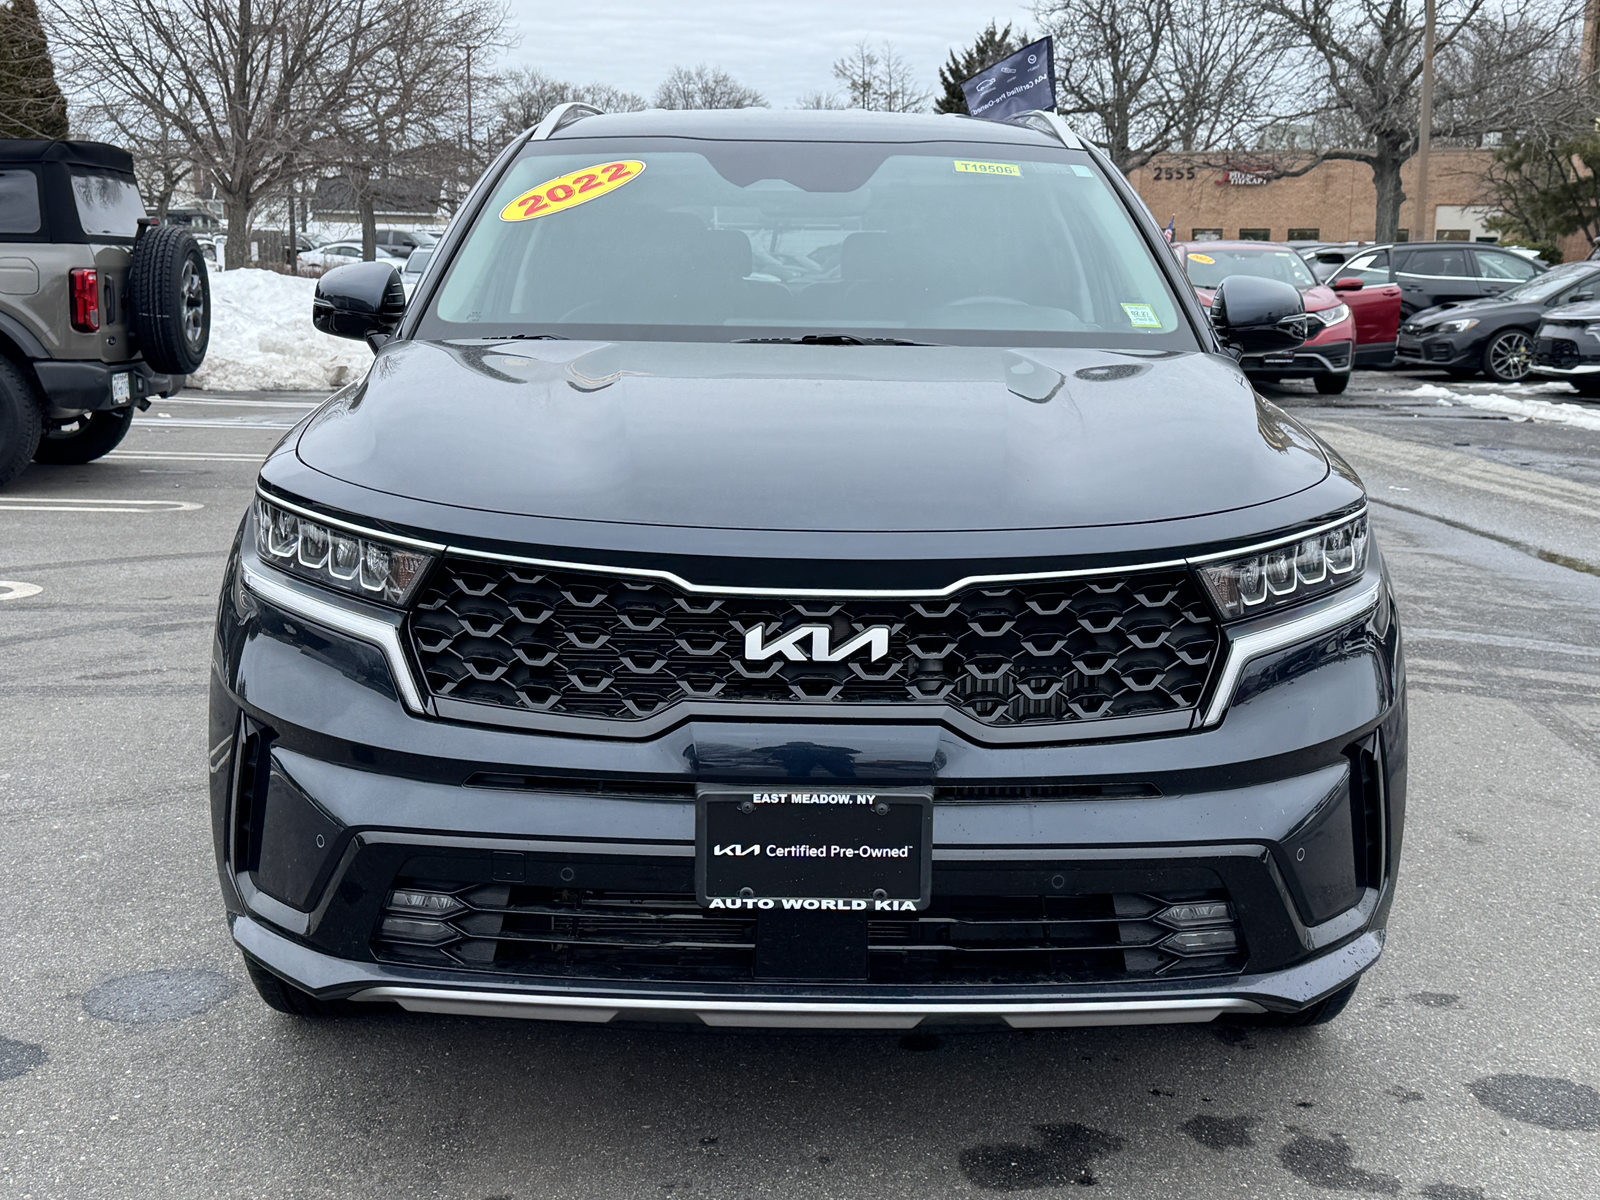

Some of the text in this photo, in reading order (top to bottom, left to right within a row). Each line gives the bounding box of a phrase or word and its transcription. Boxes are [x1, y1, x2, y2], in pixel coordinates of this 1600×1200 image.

[961, 162, 1013, 175] T19506
[1153, 167, 1196, 181] 2555
[518, 163, 634, 217] 2022
[746, 626, 888, 661] KIA
[754, 794, 787, 803] EAST
[857, 795, 875, 804] NY
[714, 845, 760, 855] KIA
[767, 845, 826, 857] Certified
[709, 899, 918, 910] AUTO WORLD KIA
